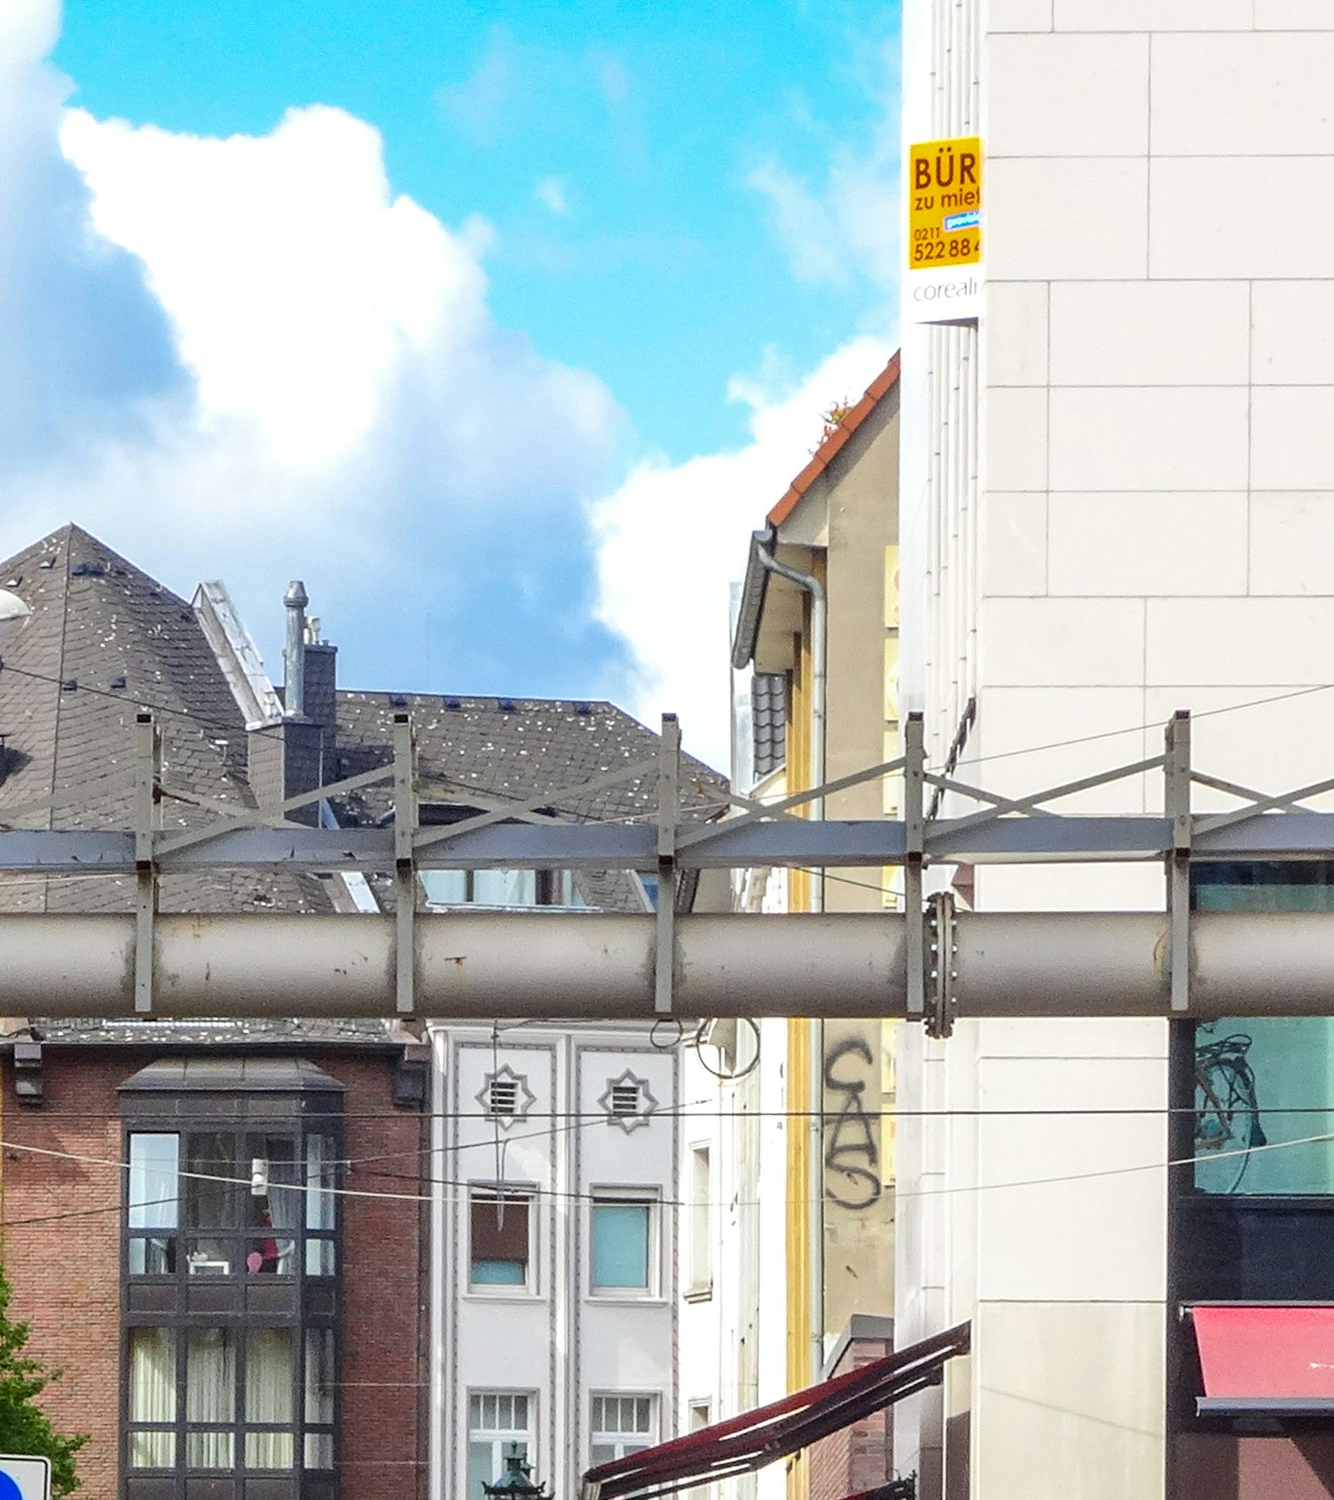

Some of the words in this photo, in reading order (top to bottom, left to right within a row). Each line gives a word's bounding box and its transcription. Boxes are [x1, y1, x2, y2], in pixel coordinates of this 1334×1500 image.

[915, 197, 934, 211] zu
[914, 228, 940, 242] 0211
[914, 242, 945, 262] 522
[949, 238, 971, 258] 88
